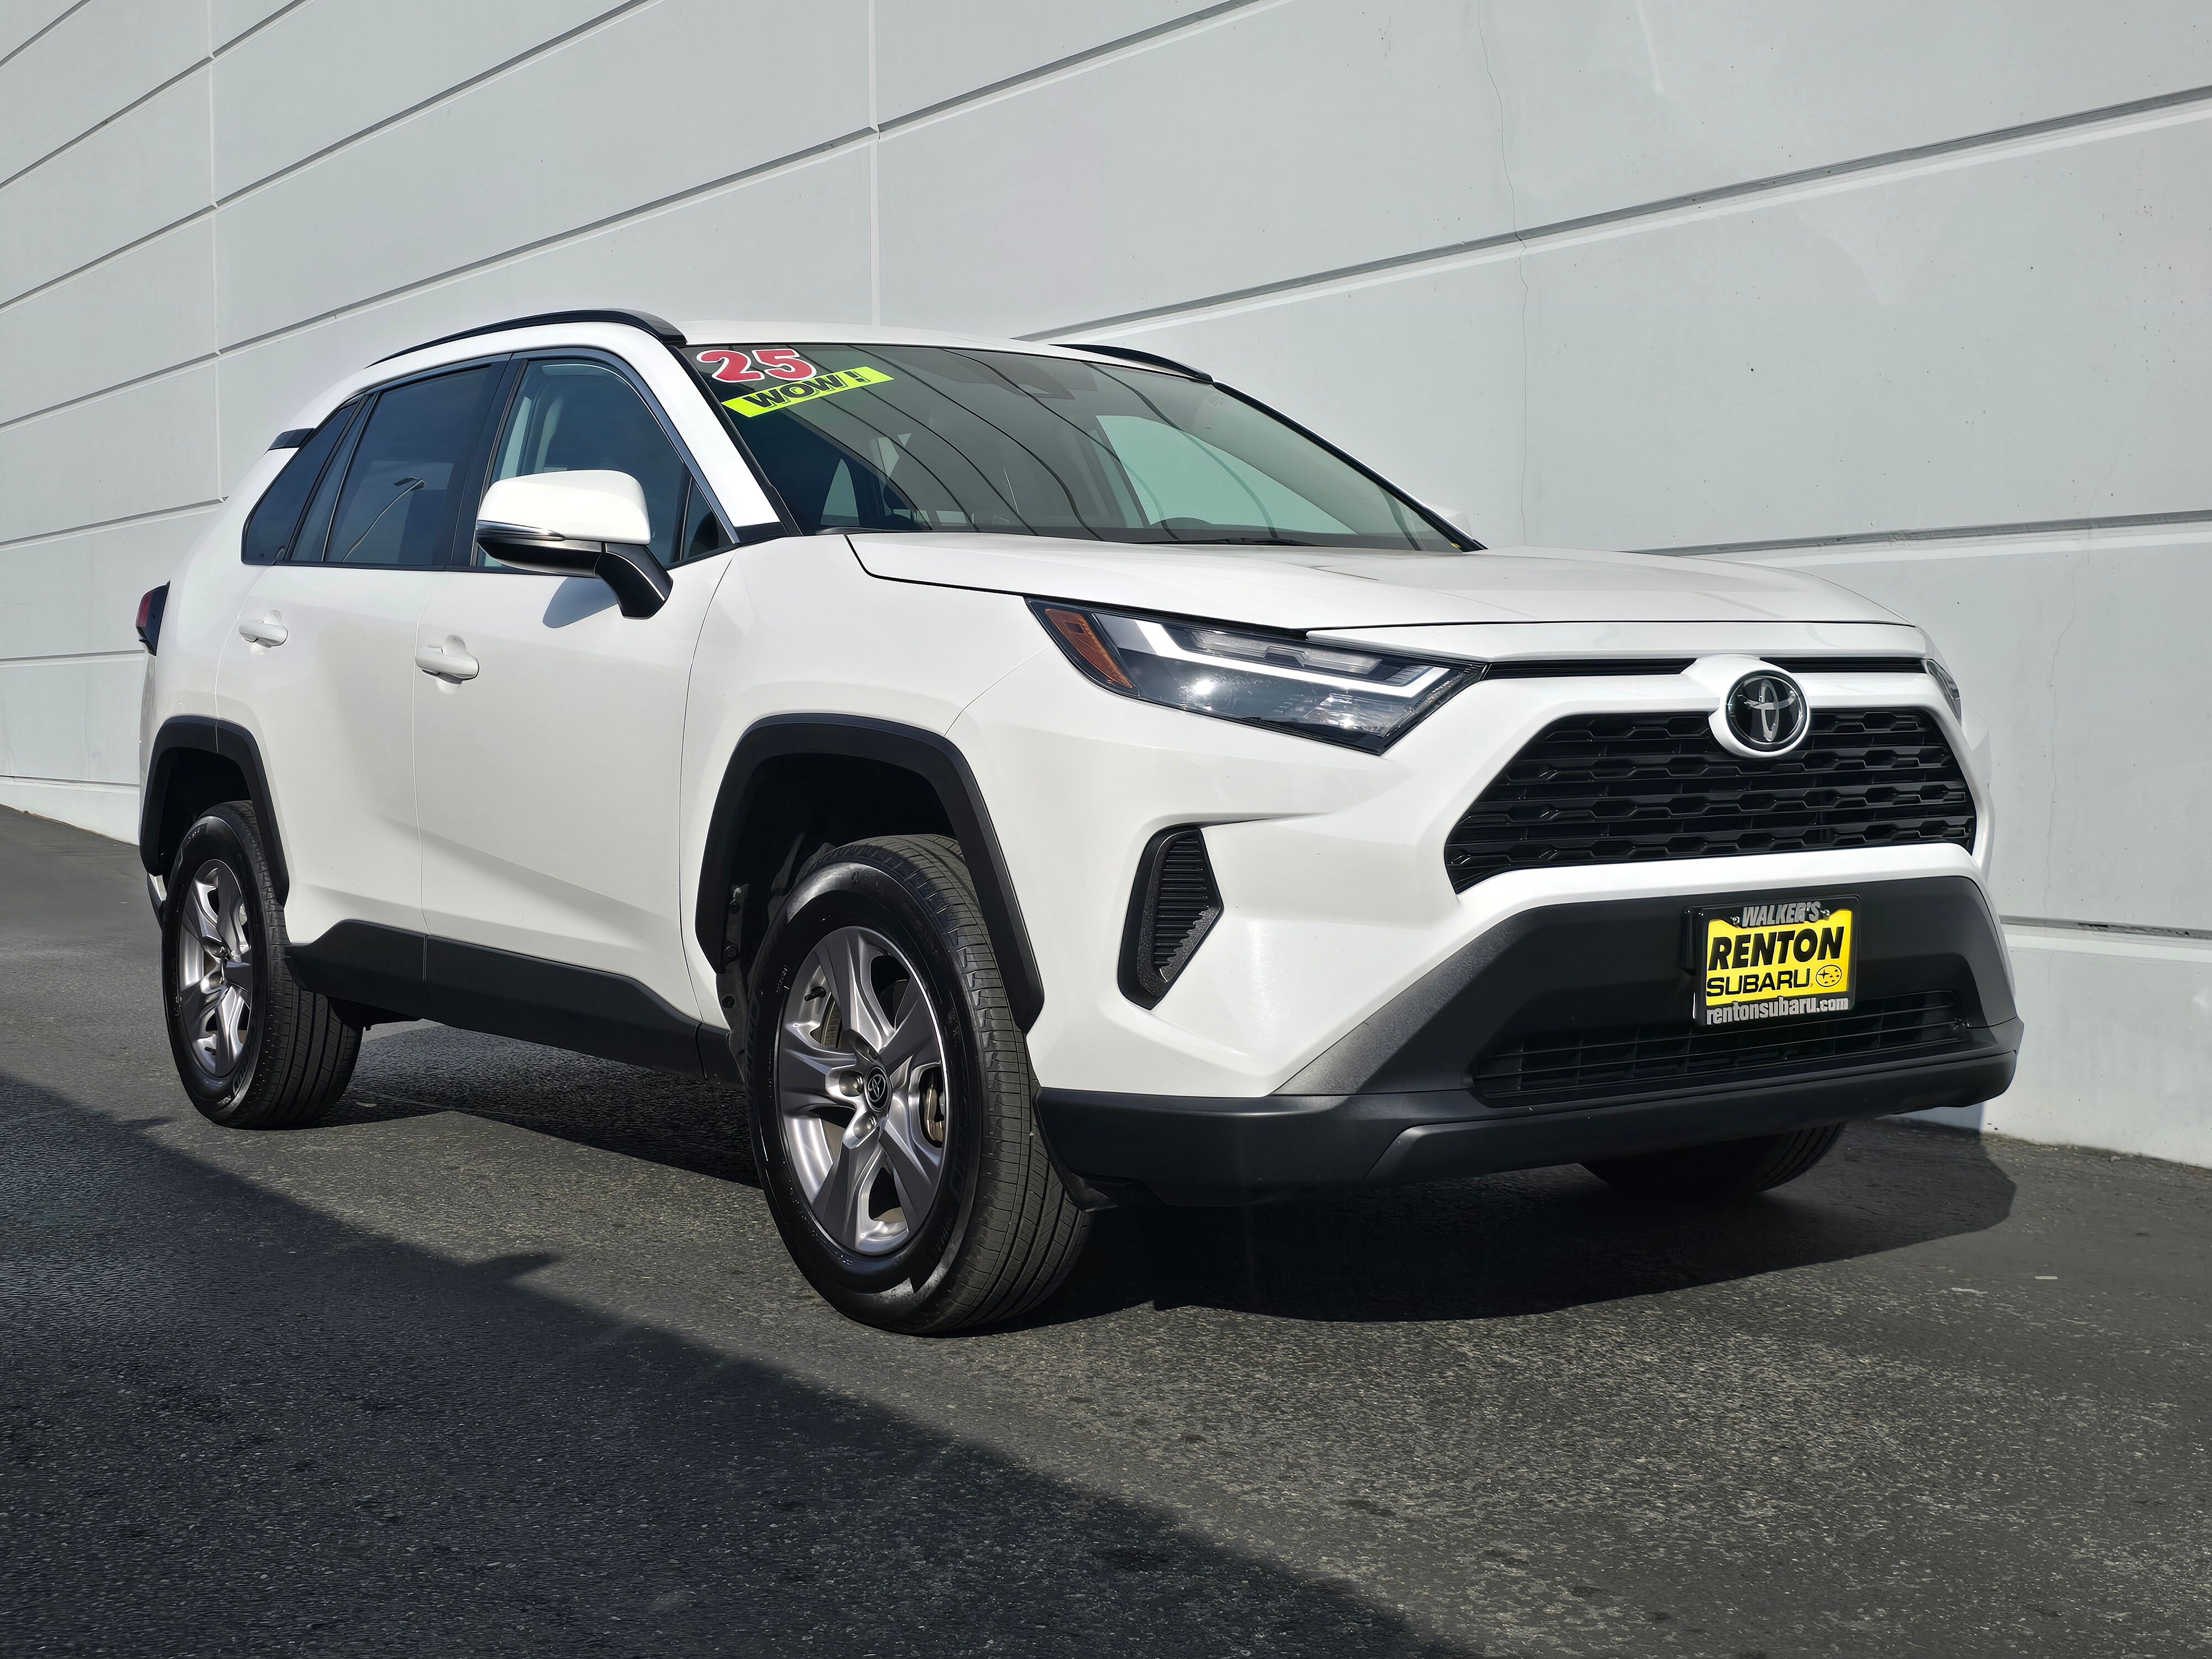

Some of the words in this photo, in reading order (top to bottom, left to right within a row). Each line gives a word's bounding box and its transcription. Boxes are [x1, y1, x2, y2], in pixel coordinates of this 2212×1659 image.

[696, 349, 817, 383] 25
[1743, 901, 1820, 927] WALKER'S
[1708, 927, 1844, 971] RENTON
[1707, 969, 1810, 997] SUBARU
[1707, 997, 1848, 1025] rentonsubaru.com
